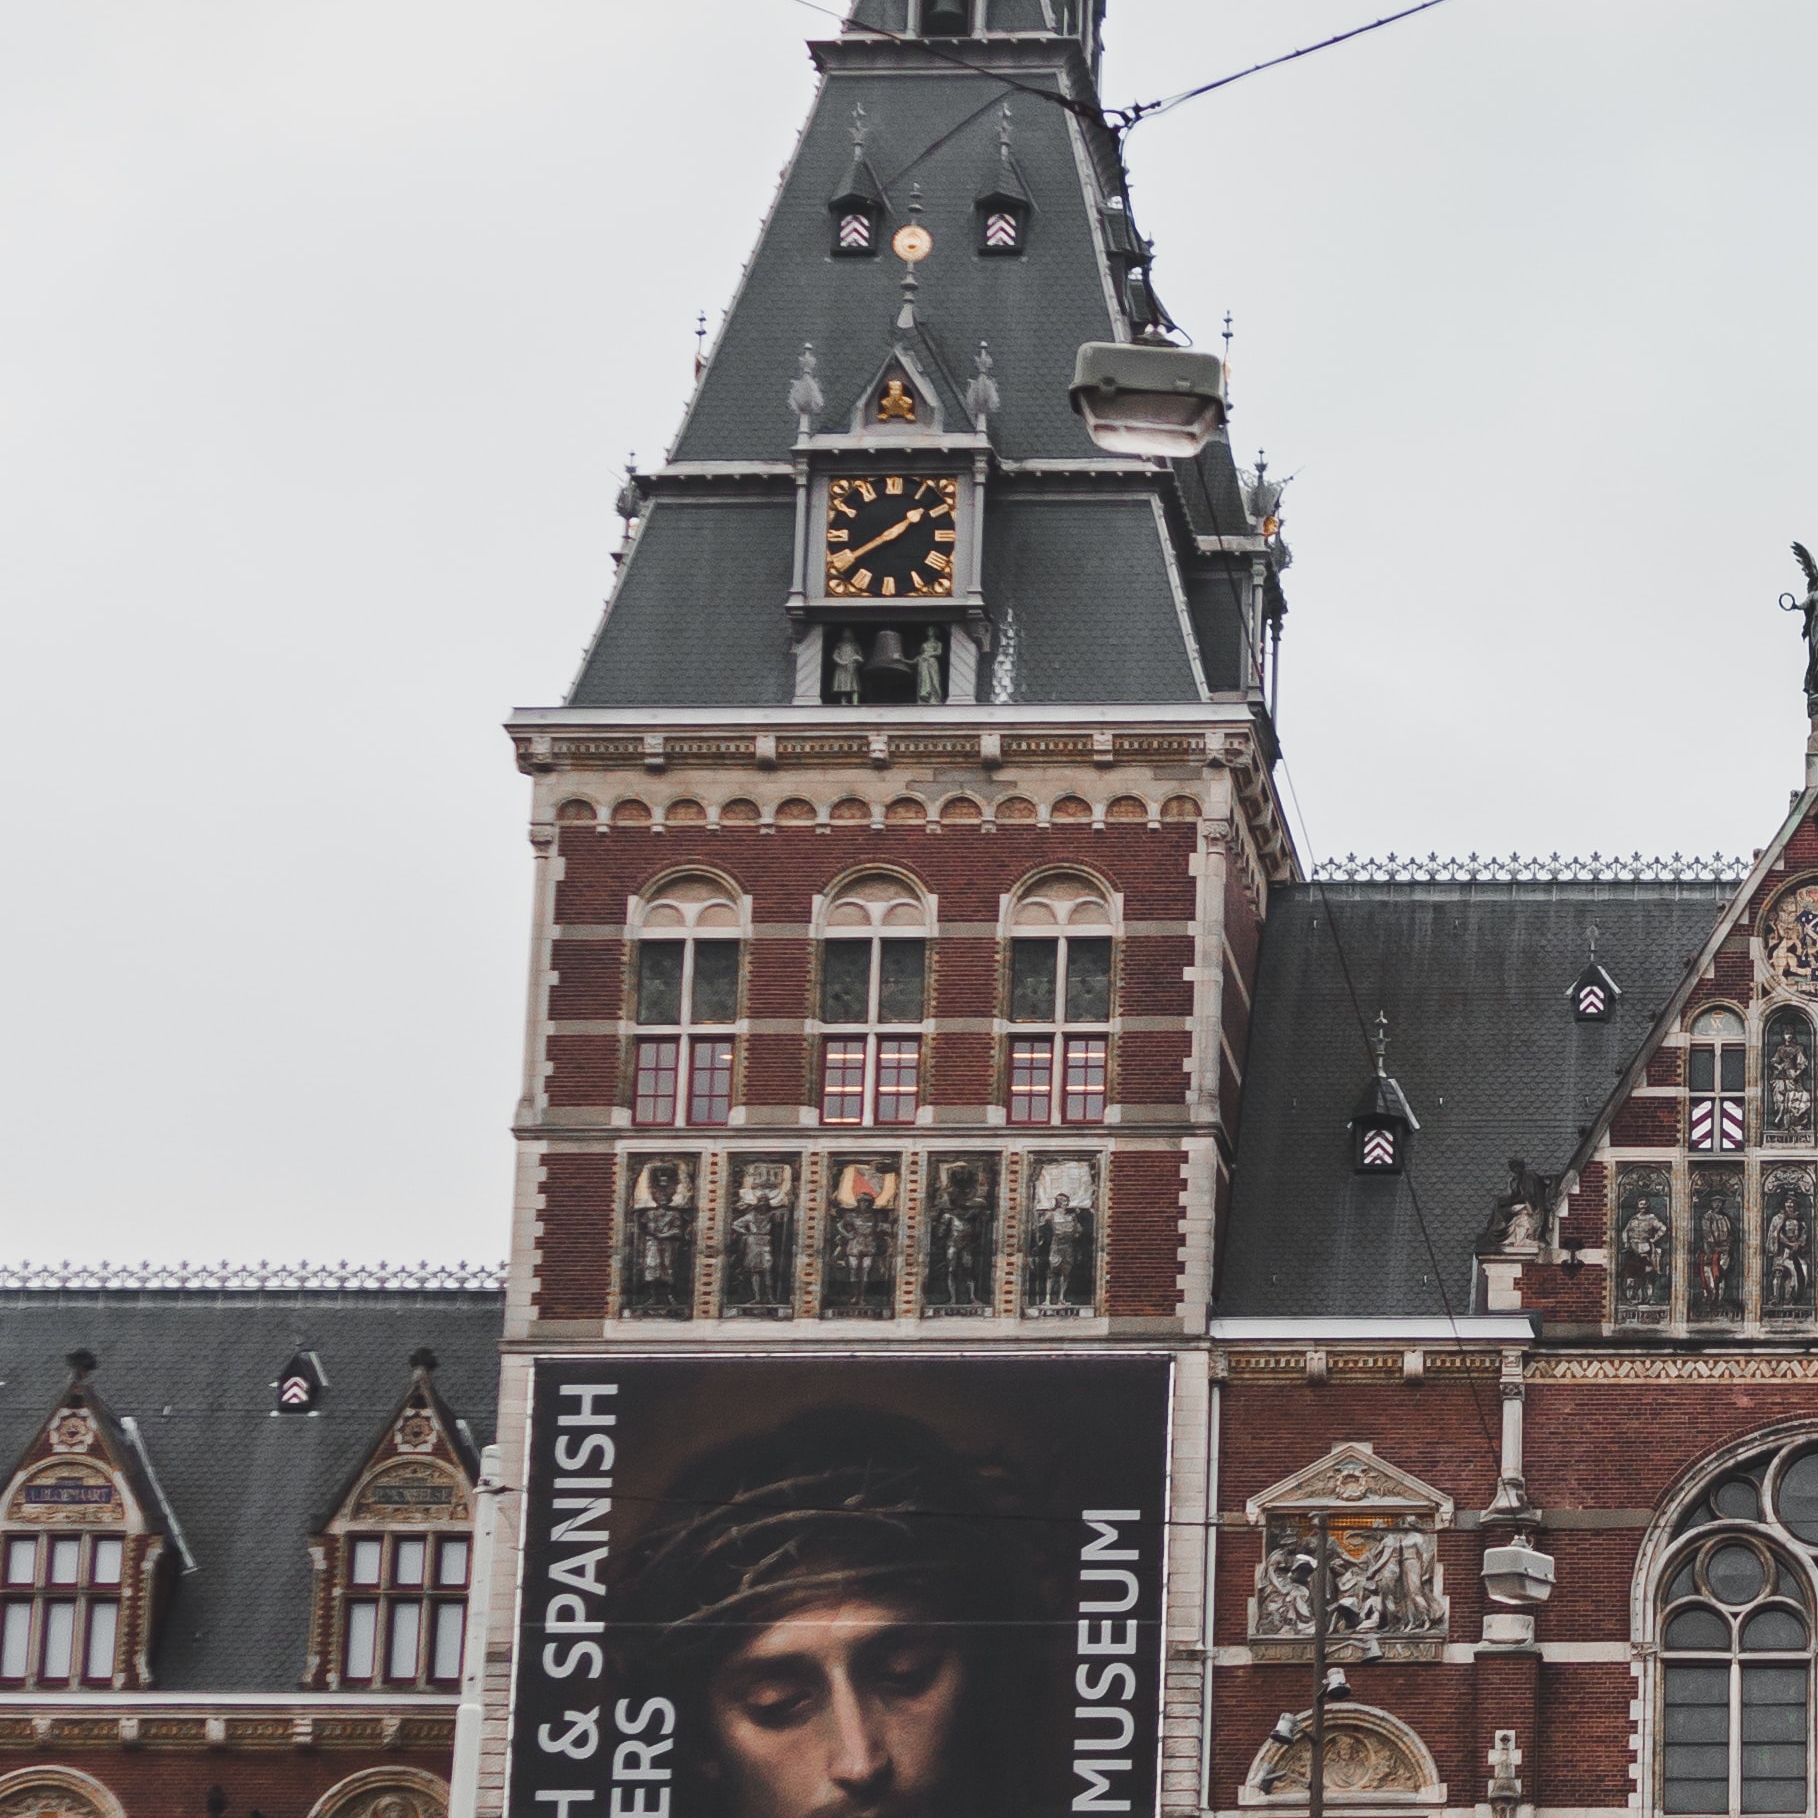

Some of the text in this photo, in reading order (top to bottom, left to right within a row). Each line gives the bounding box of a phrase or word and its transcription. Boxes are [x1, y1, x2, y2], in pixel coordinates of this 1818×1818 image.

[542, 1383, 620, 1680] SPANISH
[1069, 1508, 1142, 1812] MUSEUM
[537, 1705, 600, 1760] &
